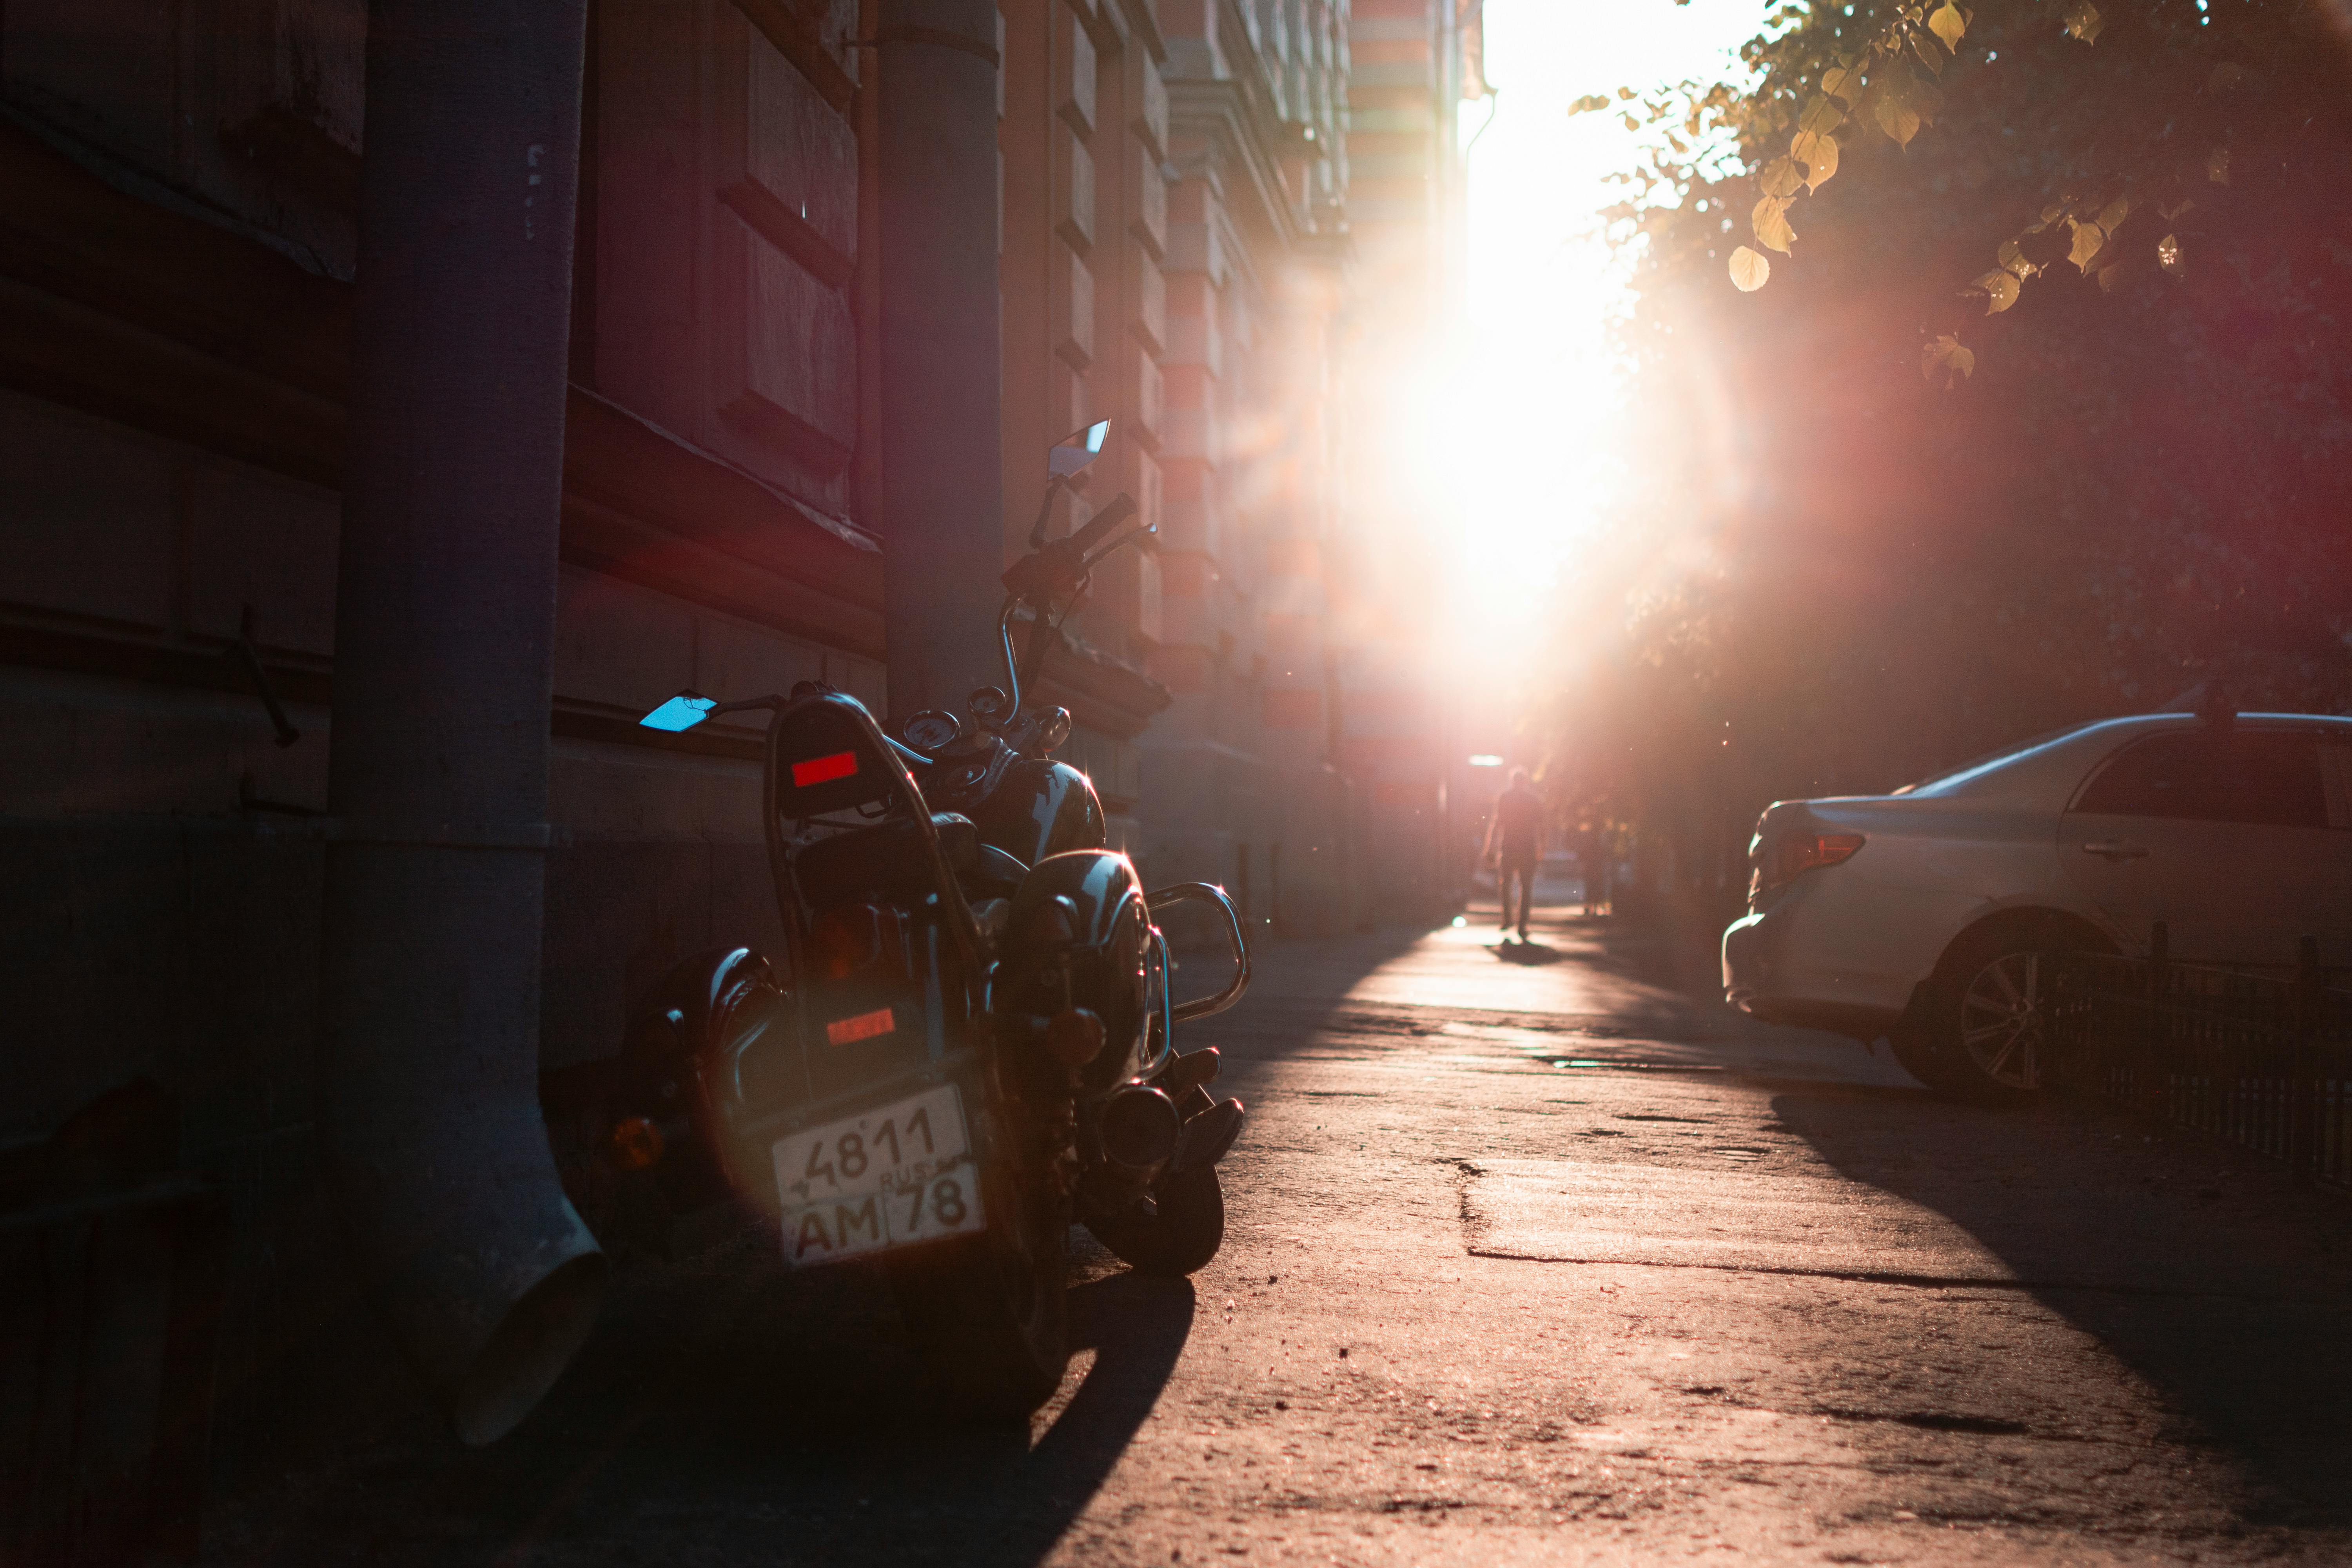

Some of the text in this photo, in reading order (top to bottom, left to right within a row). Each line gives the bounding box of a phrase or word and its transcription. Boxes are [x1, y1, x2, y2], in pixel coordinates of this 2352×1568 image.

[805, 1107, 935, 1187] 4811
[796, 1178, 966, 1258] AM 78
